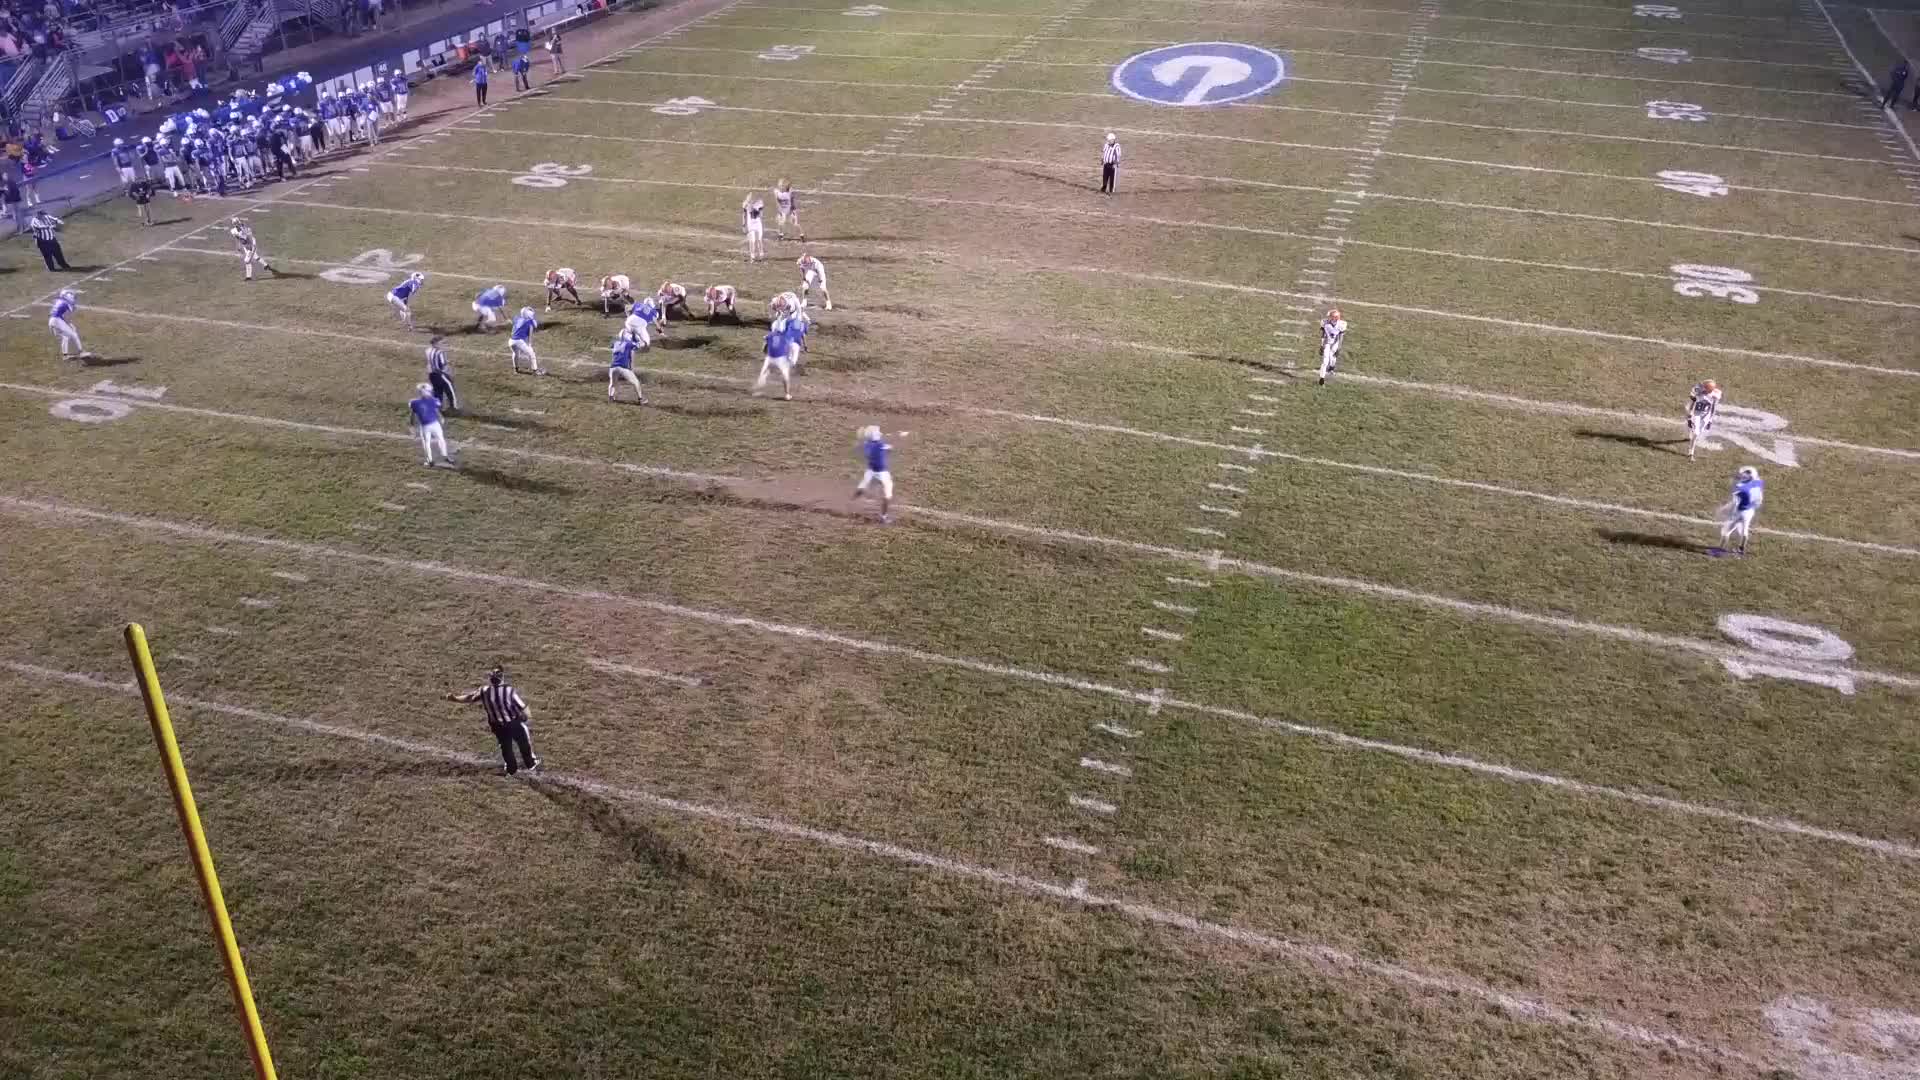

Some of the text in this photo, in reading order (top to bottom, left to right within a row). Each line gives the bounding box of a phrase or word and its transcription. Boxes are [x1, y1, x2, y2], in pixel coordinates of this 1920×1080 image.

[650, 95, 716, 115] 40
[1646, 100, 1707, 121] 50
[512, 163, 592, 187] 30
[1654, 170, 1728, 197] 40
[319, 248, 424, 284] 20
[1670, 263, 1760, 304] 30
[49, 380, 168, 424] 10
[1696, 403, 1800, 468] 20
[1717, 612, 1856, 696] 10
